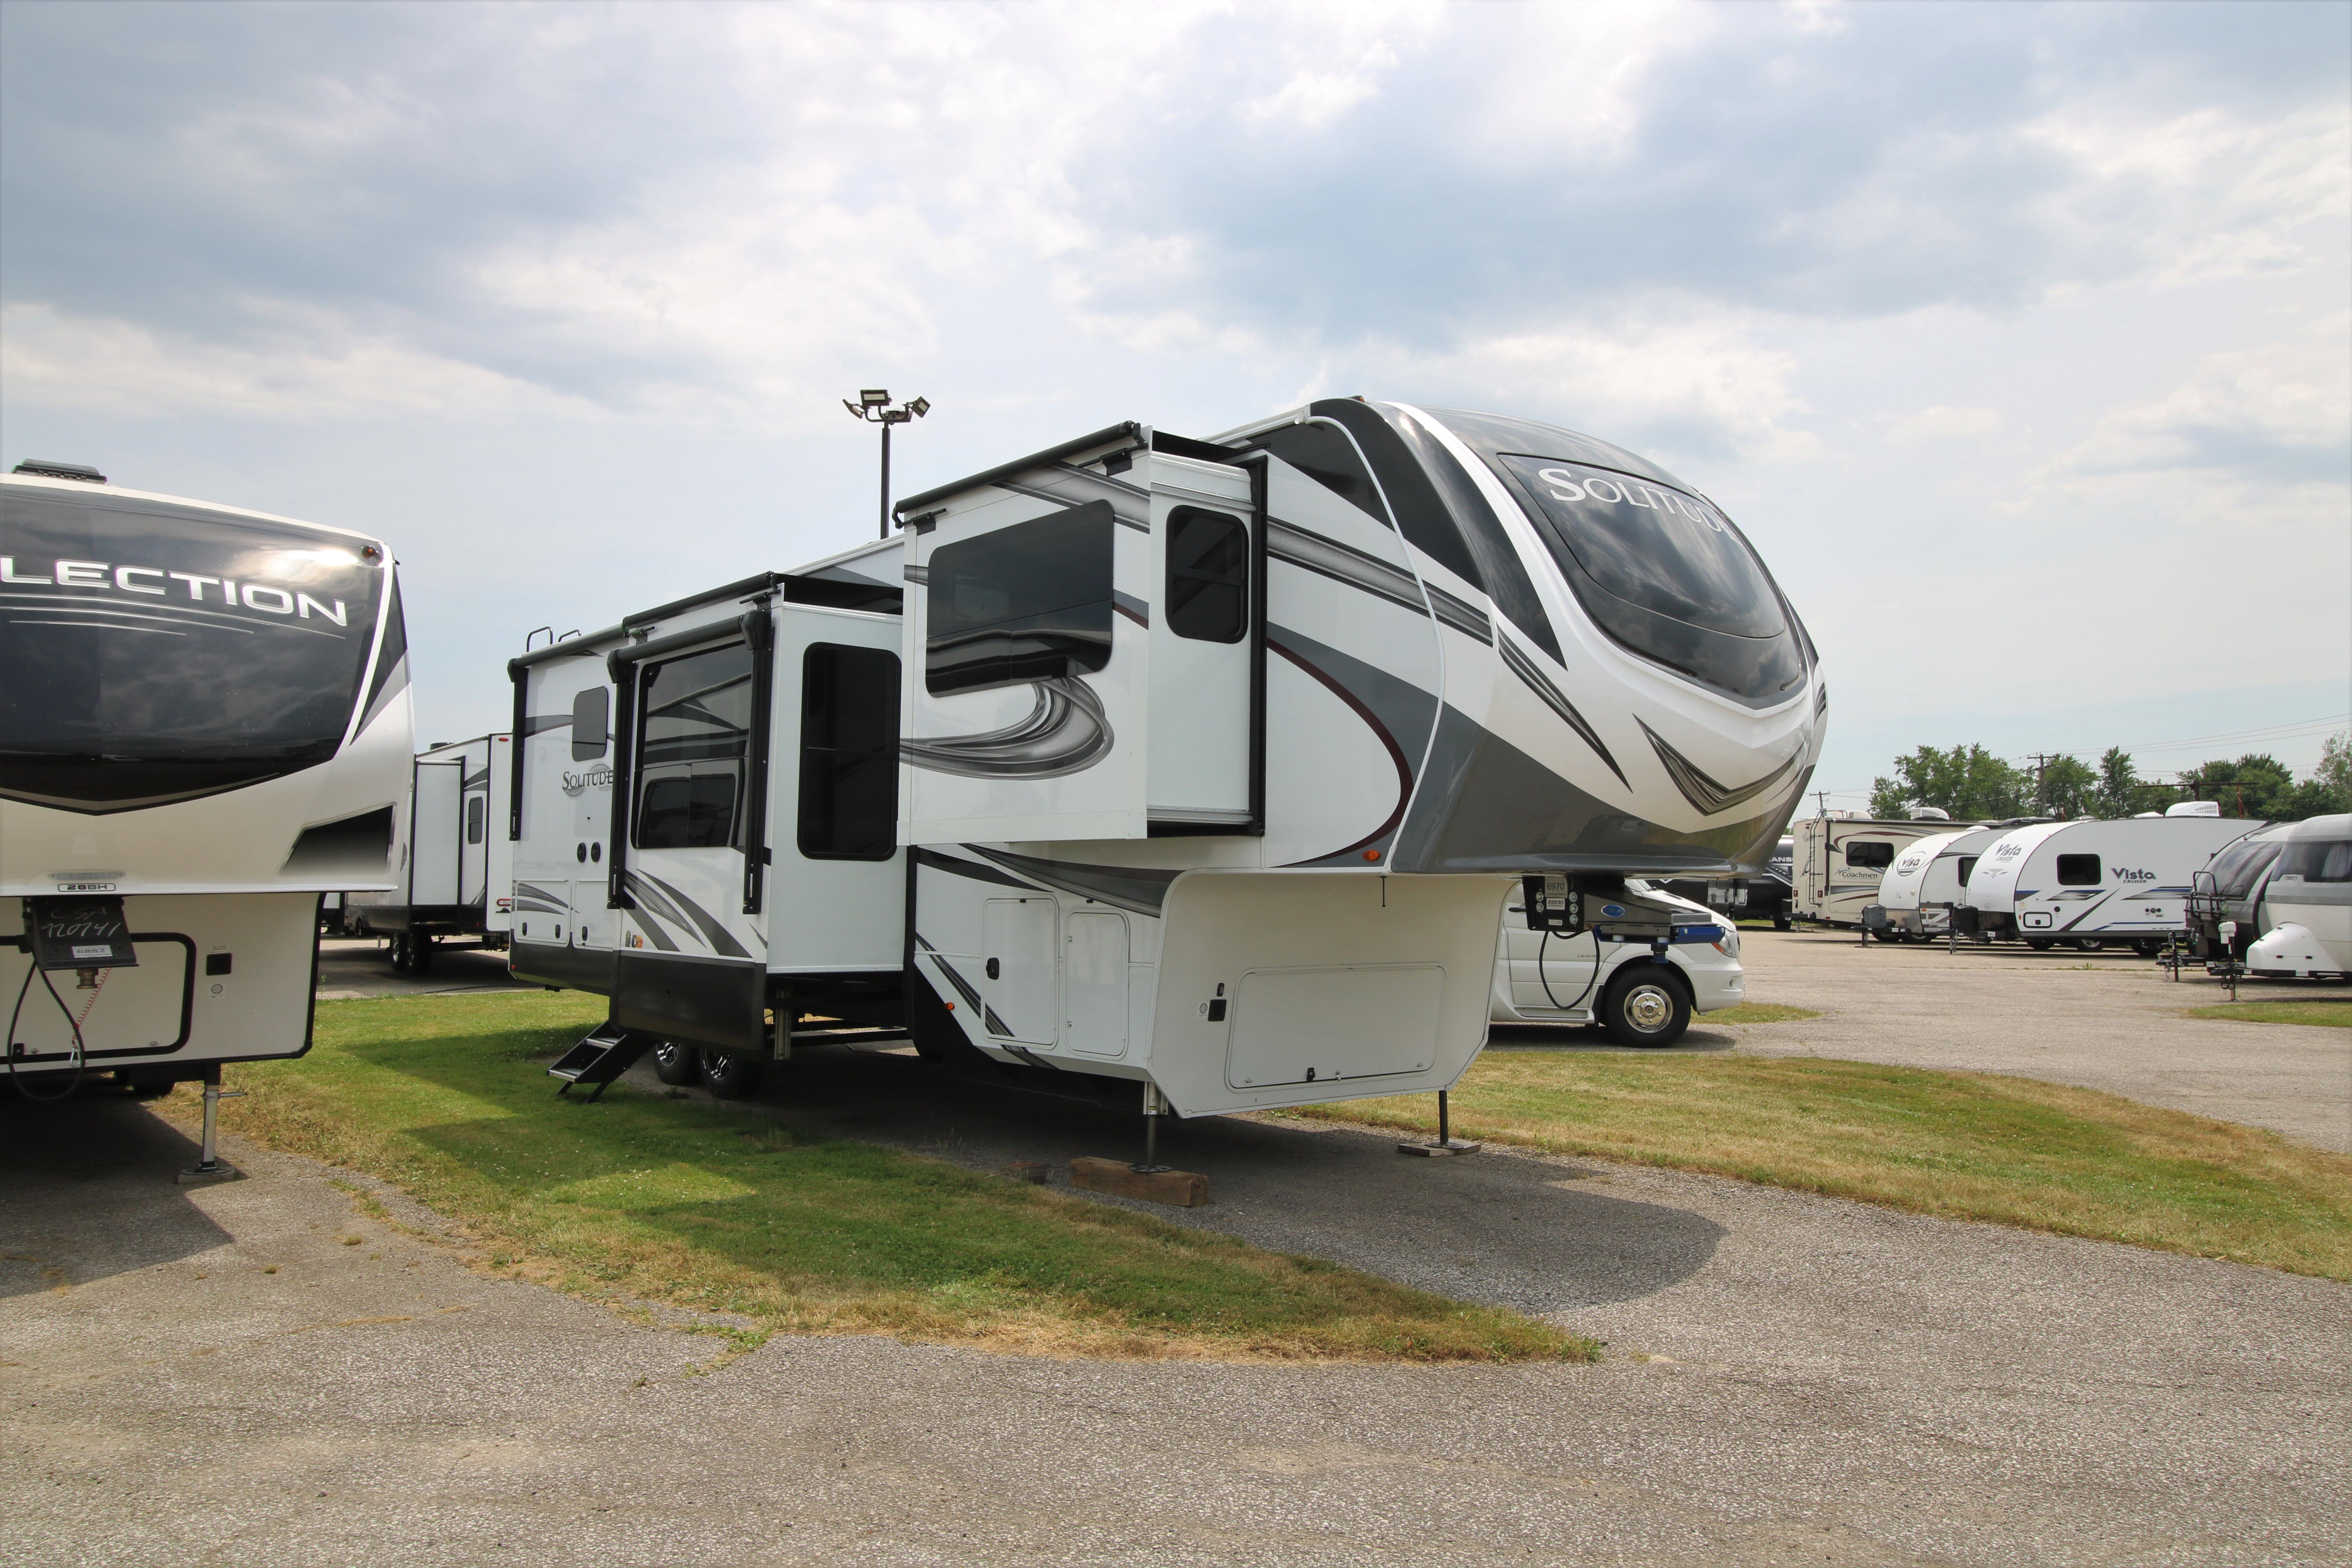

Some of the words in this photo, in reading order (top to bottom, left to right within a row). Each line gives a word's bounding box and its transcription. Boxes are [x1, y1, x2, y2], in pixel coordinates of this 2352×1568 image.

[1538, 468, 1744, 547] SOLITUDE
[562, 769, 613, 789] SOLITUDE
[1995, 844, 2022, 856] Vista
[2111, 867, 2156, 880] Vista
